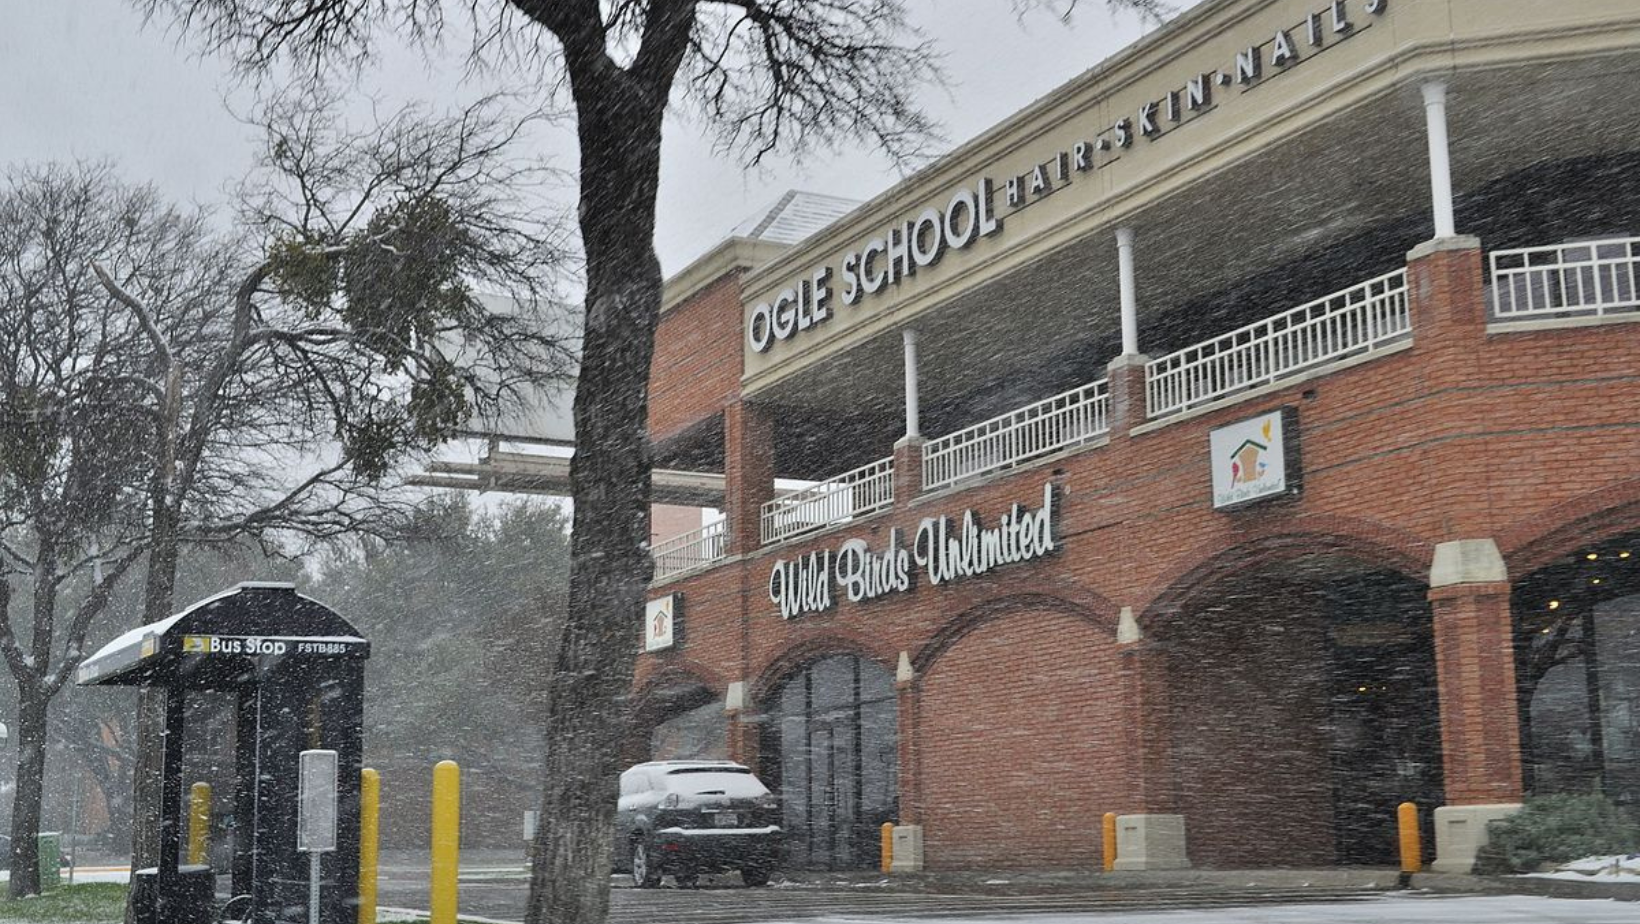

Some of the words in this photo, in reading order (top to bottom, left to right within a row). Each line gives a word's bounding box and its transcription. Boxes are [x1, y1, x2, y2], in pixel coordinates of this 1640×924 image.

[1006, 139, 1093, 208] HAIR
[1114, 72, 1212, 148] SKIN
[749, 266, 832, 353] OGLE
[841, 177, 1002, 306] SCHOOL
[770, 549, 830, 620] Wild
[836, 527, 909, 602] Birds
[914, 482, 1054, 585] Unlimited
[211, 637, 241, 654] Bus
[245, 638, 286, 656] Stop
